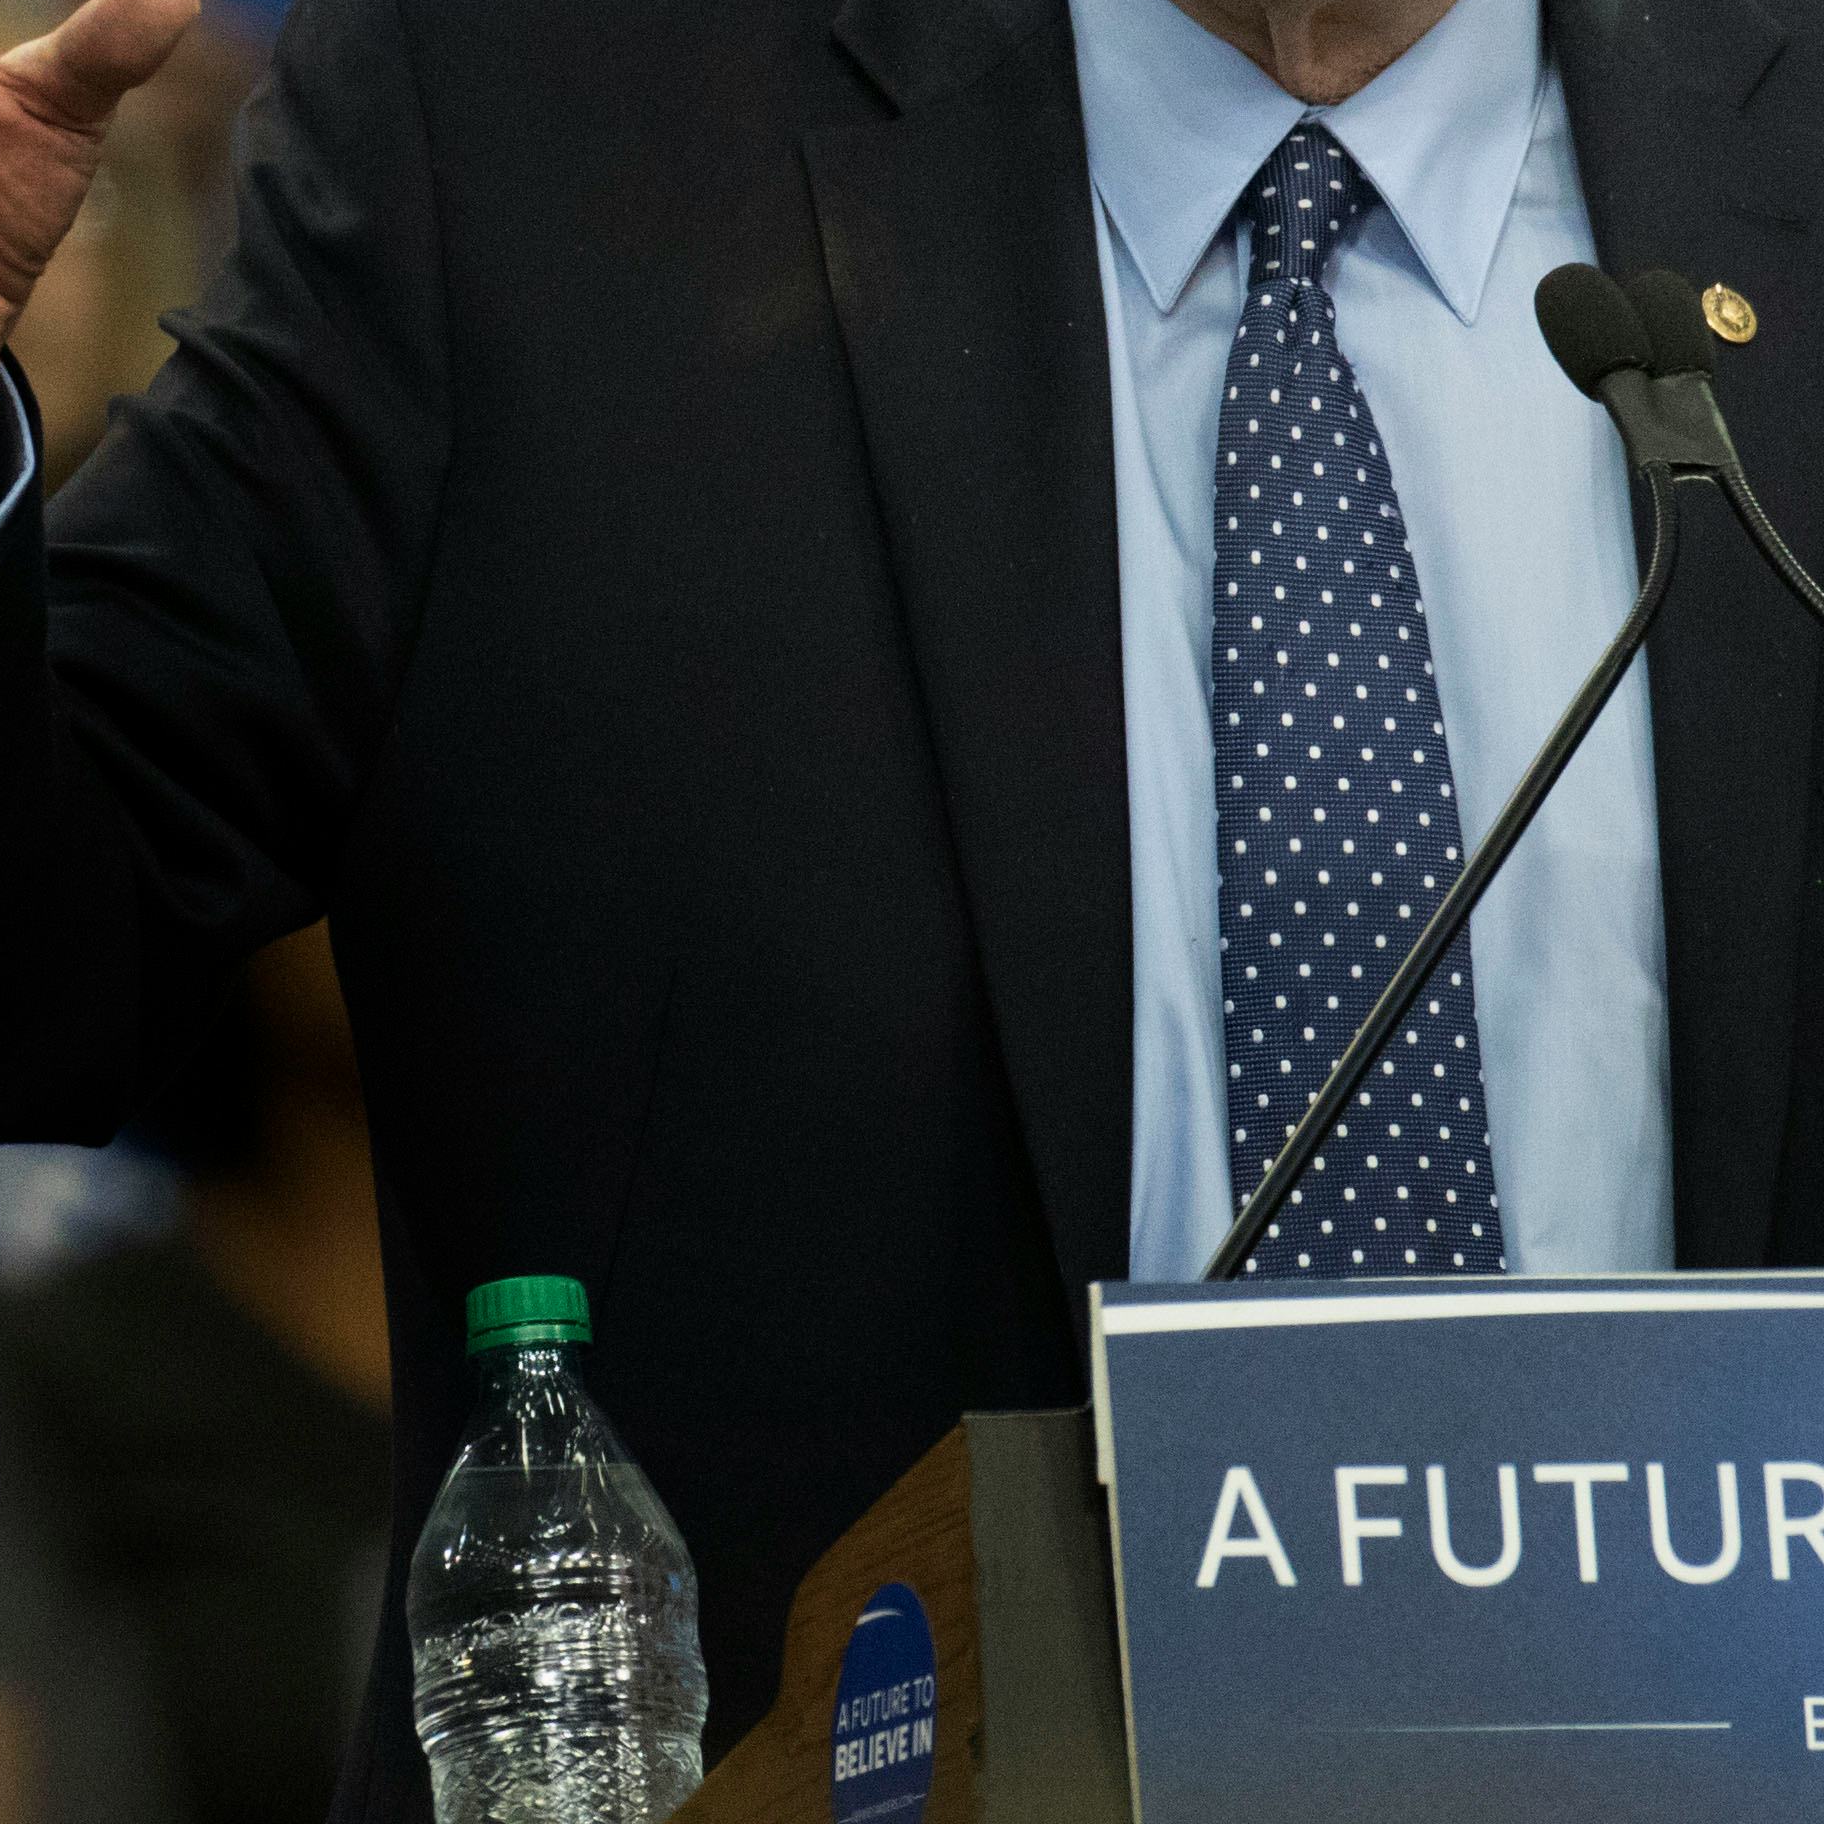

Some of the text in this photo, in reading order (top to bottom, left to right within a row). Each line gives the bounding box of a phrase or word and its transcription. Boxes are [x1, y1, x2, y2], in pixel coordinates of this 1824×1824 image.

[1194, 1465, 1298, 1589] A
[836, 1674, 935, 1734] A FUTURE TO
[834, 1716, 933, 1782] BELIEVE IN
